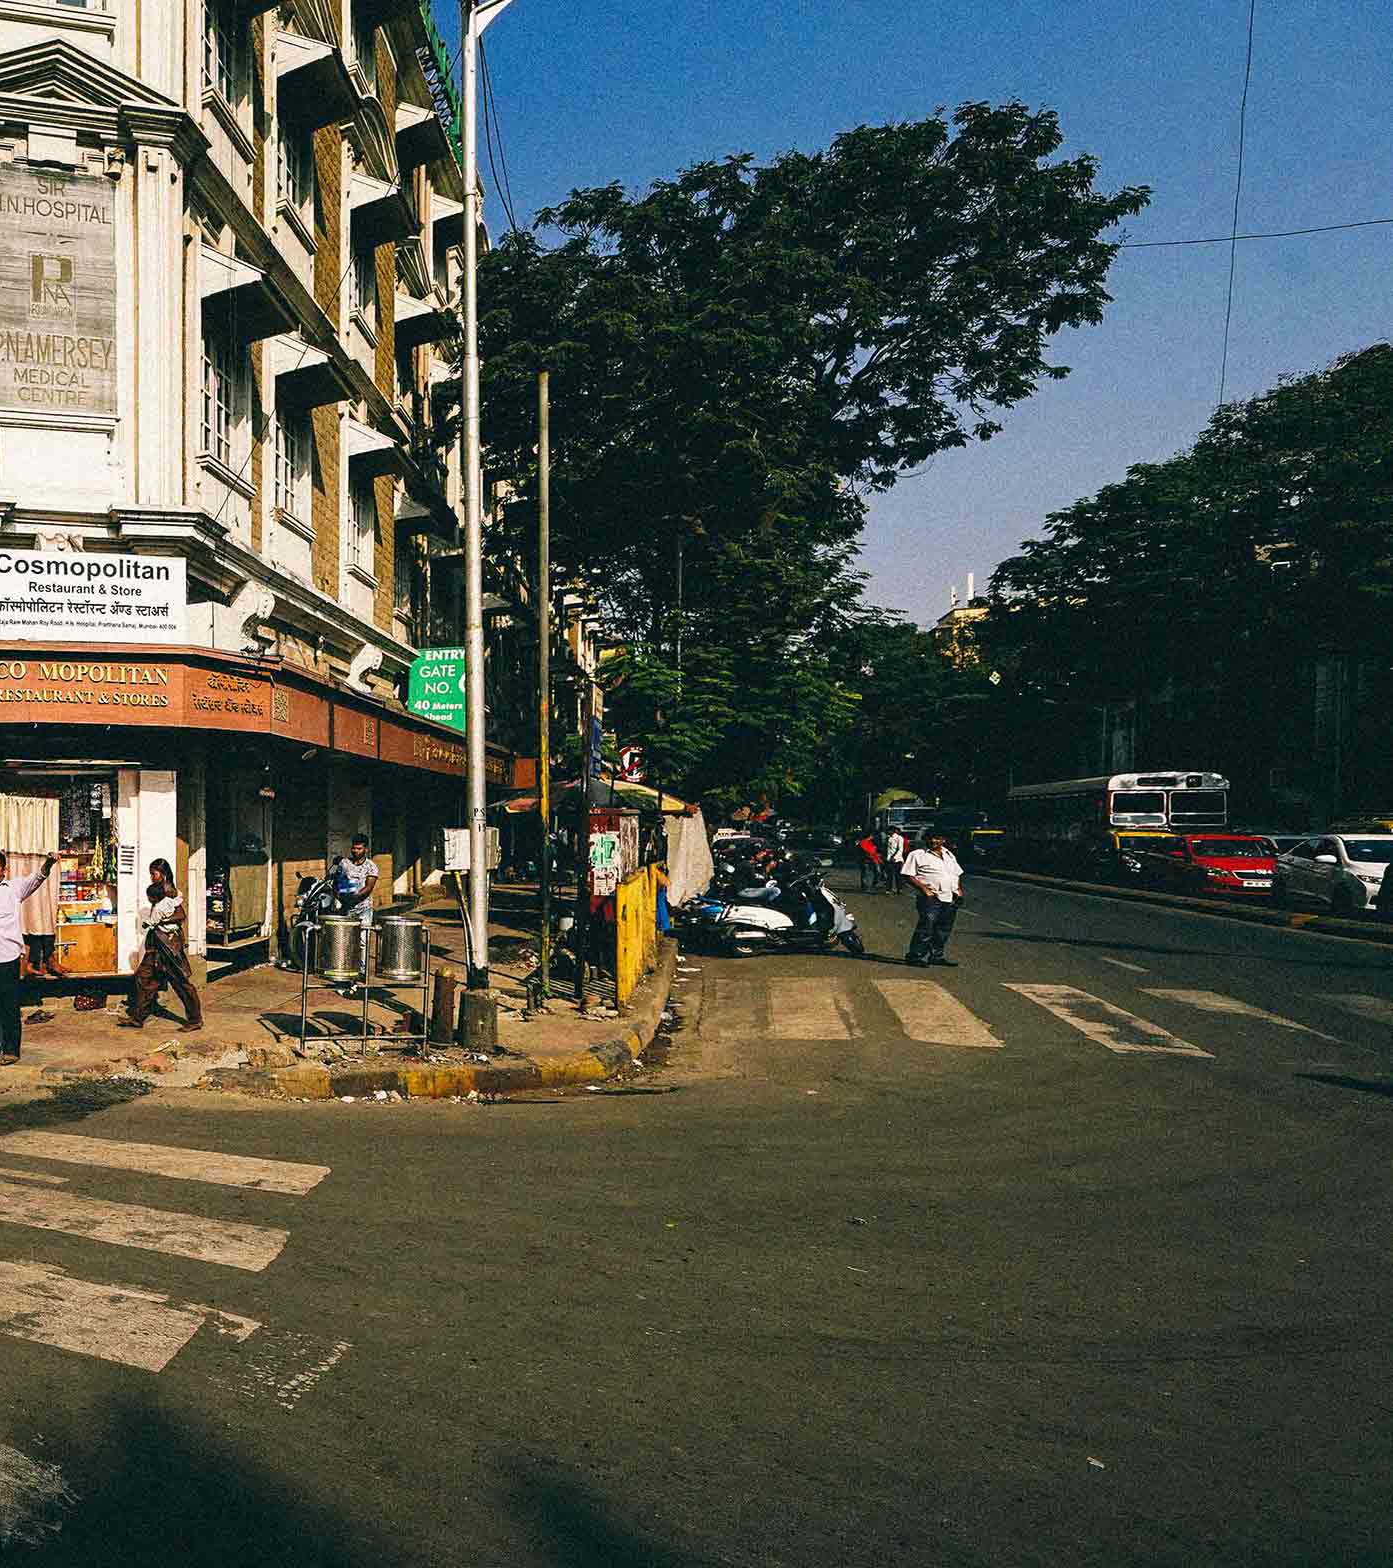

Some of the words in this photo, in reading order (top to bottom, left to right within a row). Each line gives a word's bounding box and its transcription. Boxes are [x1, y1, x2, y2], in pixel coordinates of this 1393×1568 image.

[37, 179, 66, 197] SIR
[13, 367, 89, 387] MEDICAL
[17, 386, 90, 405] CENTRE
[28, 581, 95, 594] Restaurant
[98, 584, 107, 595] &
[110, 584, 142, 596] Store
[67, 599, 107, 615] रेस्टॉरन्ट
[426, 649, 465, 660] ENTRY
[419, 664, 456, 678] GATE
[424, 681, 453, 695] NO.
[98, 692, 110, 705] &
[112, 691, 168, 707] STORES
[414, 700, 430, 710] 40
[432, 702, 463, 710] Meters
